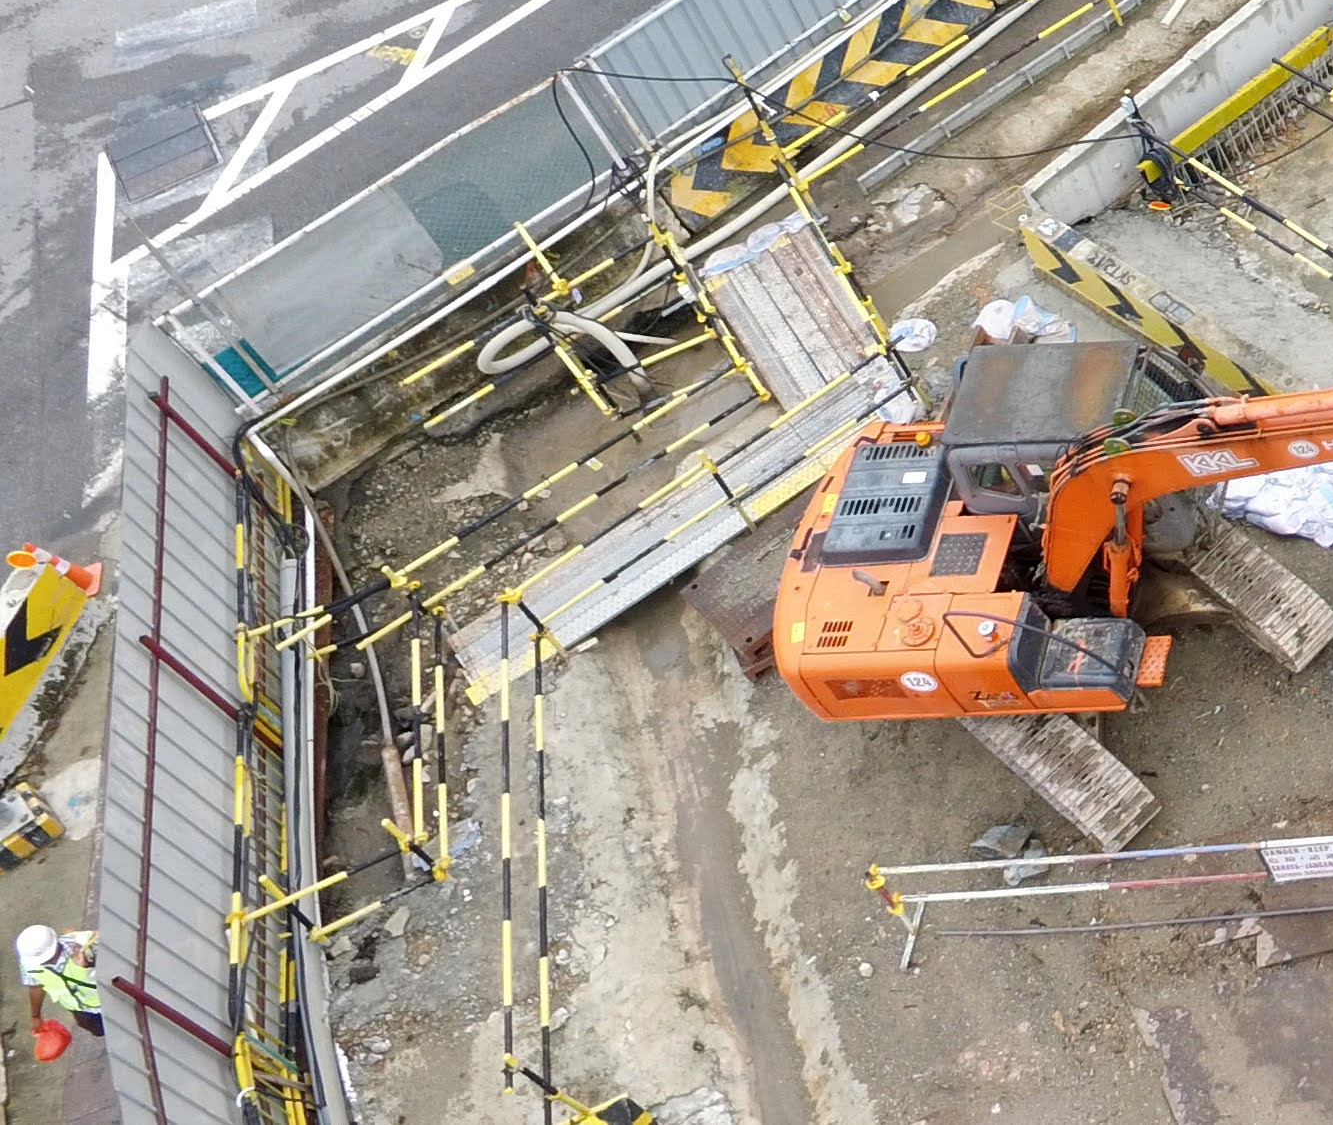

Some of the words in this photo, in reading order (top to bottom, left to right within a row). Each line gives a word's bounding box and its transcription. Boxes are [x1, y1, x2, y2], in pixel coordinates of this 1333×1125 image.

[1292, 442, 1315, 455] 124
[1177, 449, 1260, 476] KKL
[906, 675, 932, 687] 124
